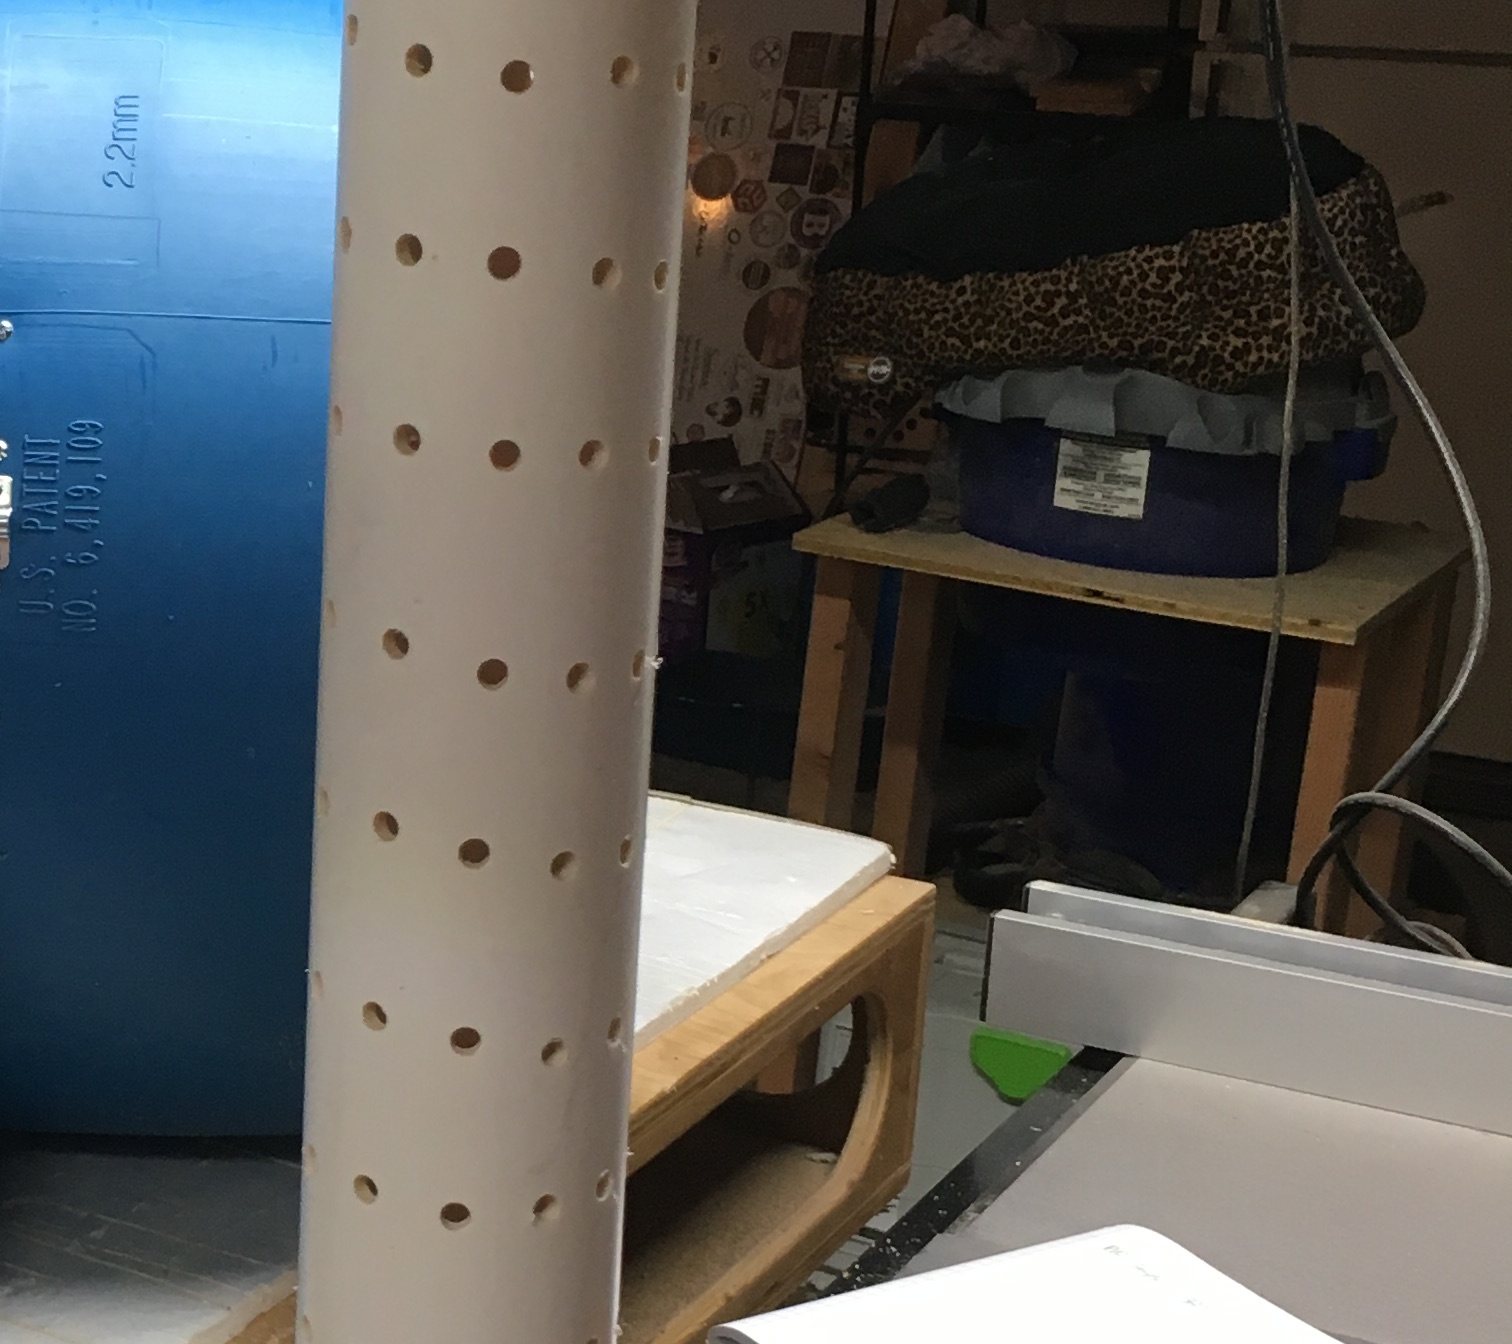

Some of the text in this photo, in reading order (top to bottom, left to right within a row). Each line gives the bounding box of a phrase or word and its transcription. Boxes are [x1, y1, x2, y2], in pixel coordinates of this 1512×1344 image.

[102, 95, 139, 188] 2.2mm
[19, 434, 61, 614] U.S. PATENT
[61, 419, 108, 632] NO. 6,419,109
